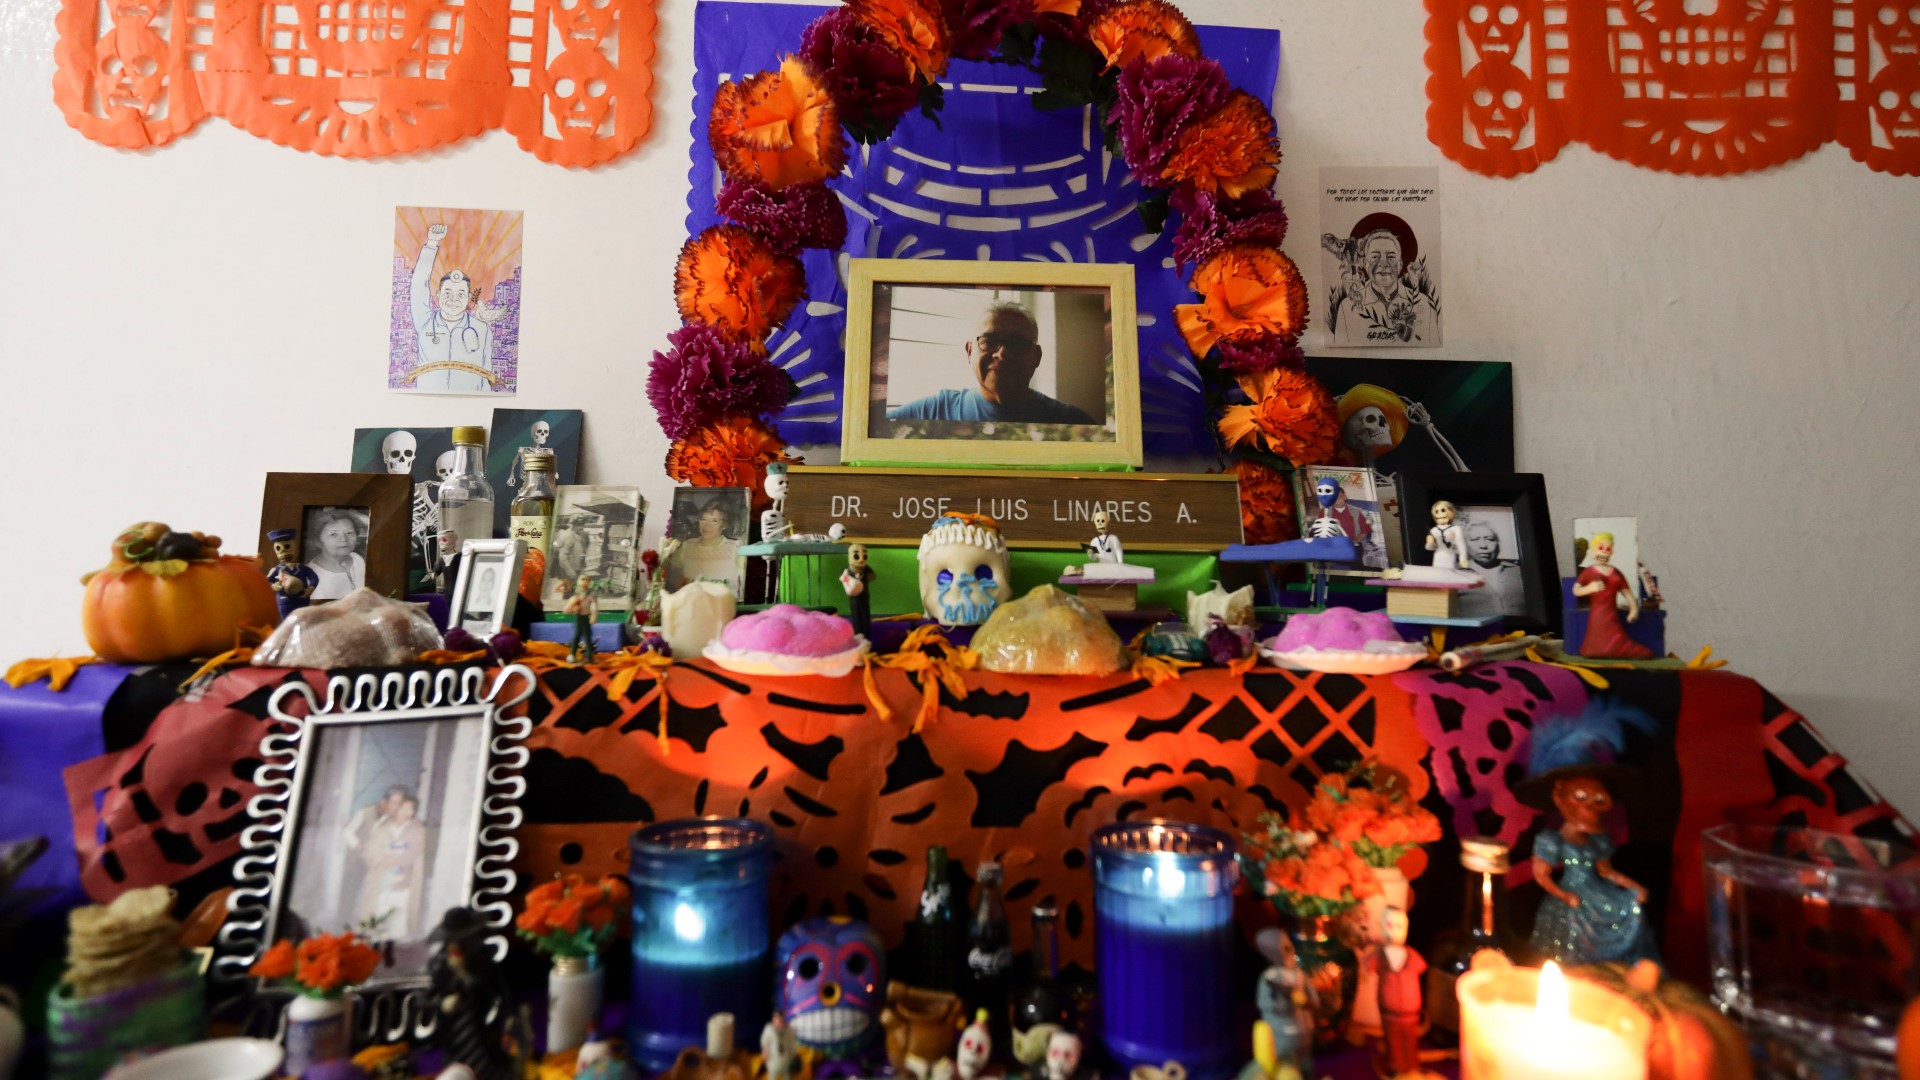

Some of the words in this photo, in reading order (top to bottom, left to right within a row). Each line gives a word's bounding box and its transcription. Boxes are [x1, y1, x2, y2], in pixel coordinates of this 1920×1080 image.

[1396, 188, 1408, 197] QUE
[1366, 331, 1397, 340] GRACIAS
[831, 495, 868, 518] DR.
[892, 497, 952, 519] JOSE
[1053, 499, 1153, 523] LINARES
[1176, 502, 1198, 524] A.
